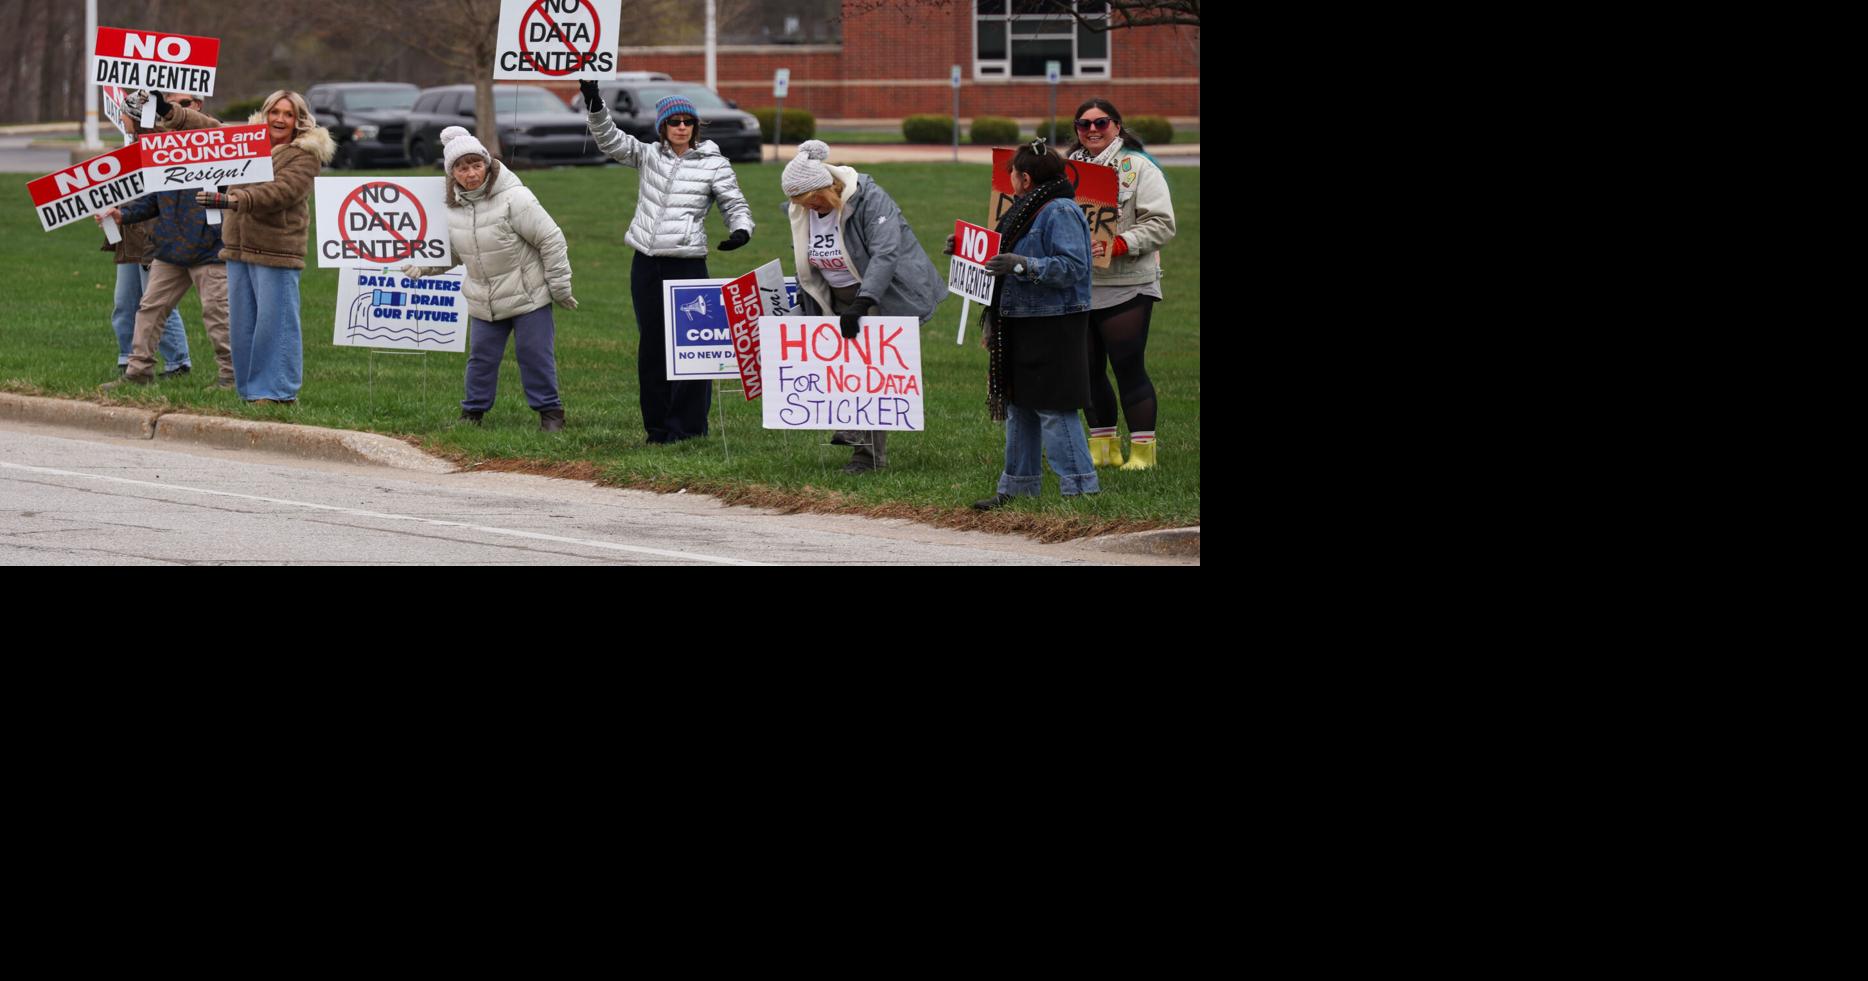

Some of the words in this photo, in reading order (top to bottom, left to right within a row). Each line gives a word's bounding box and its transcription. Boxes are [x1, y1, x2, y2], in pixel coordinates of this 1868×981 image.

[544, 0, 579, 13] NO
[530, 22, 590, 42] DATA
[123, 33, 191, 62] NO
[500, 51, 613, 72] CENTERS
[96, 59, 140, 86] DATA
[146, 64, 210, 93] CENTER
[141, 131, 224, 151] MAYOR
[231, 128, 266, 142] and
[152, 142, 257, 165] COUNCIL
[54, 155, 122, 196] NO
[164, 160, 251, 185] Resign!
[362, 184, 400, 204] NO
[42, 191, 90, 227] DATA
[350, 212, 417, 232] DATA
[323, 239, 445, 260] CENTERS
[813, 233, 835, 248] 25
[961, 226, 989, 262] NO
[358, 275, 395, 288] DATA
[400, 278, 461, 292] CENTERS
[950, 258, 968, 292] DATA
[965, 264, 994, 301] CENTER
[411, 294, 455, 307] DRAIN
[727, 284, 745, 315] and
[373, 308, 402, 319] OUR
[406, 310, 458, 323] FUTURE
[697, 351, 722, 359] NEW
[779, 323, 909, 370] HONK
[733, 320, 761, 398] MAYOR
